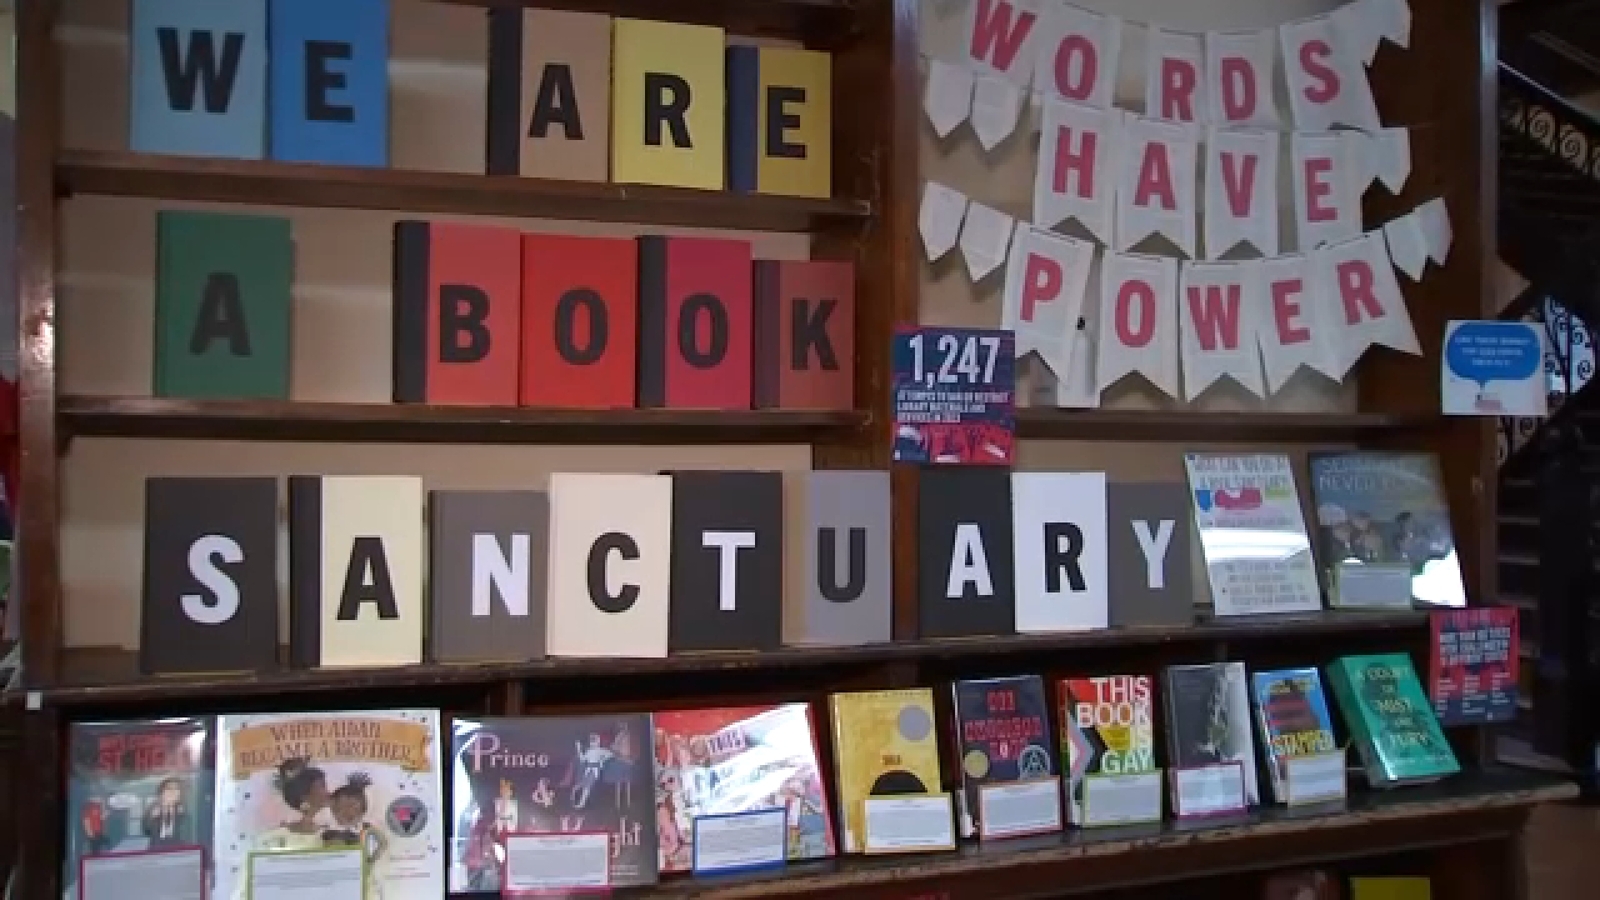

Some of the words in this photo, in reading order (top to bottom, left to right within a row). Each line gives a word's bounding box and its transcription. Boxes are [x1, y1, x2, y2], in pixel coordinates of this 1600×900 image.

[157, 27, 355, 122] WE
[528, 63, 807, 159] ARE
[969, 0, 1341, 123] WORDS
[1052, 125, 1339, 223] HAVE
[189, 272, 252, 357] A
[439, 284, 840, 371] BOOK
[1019, 252, 1386, 351] POWER
[909, 334, 1000, 388] 1,247
[180, 519, 1177, 624] SANCTUARY
[1077, 702, 1151, 728] BOOK
[1090, 677, 1151, 704] THIS
[467, 732, 549, 773] Prince
[1102, 748, 1153, 773] GAY
